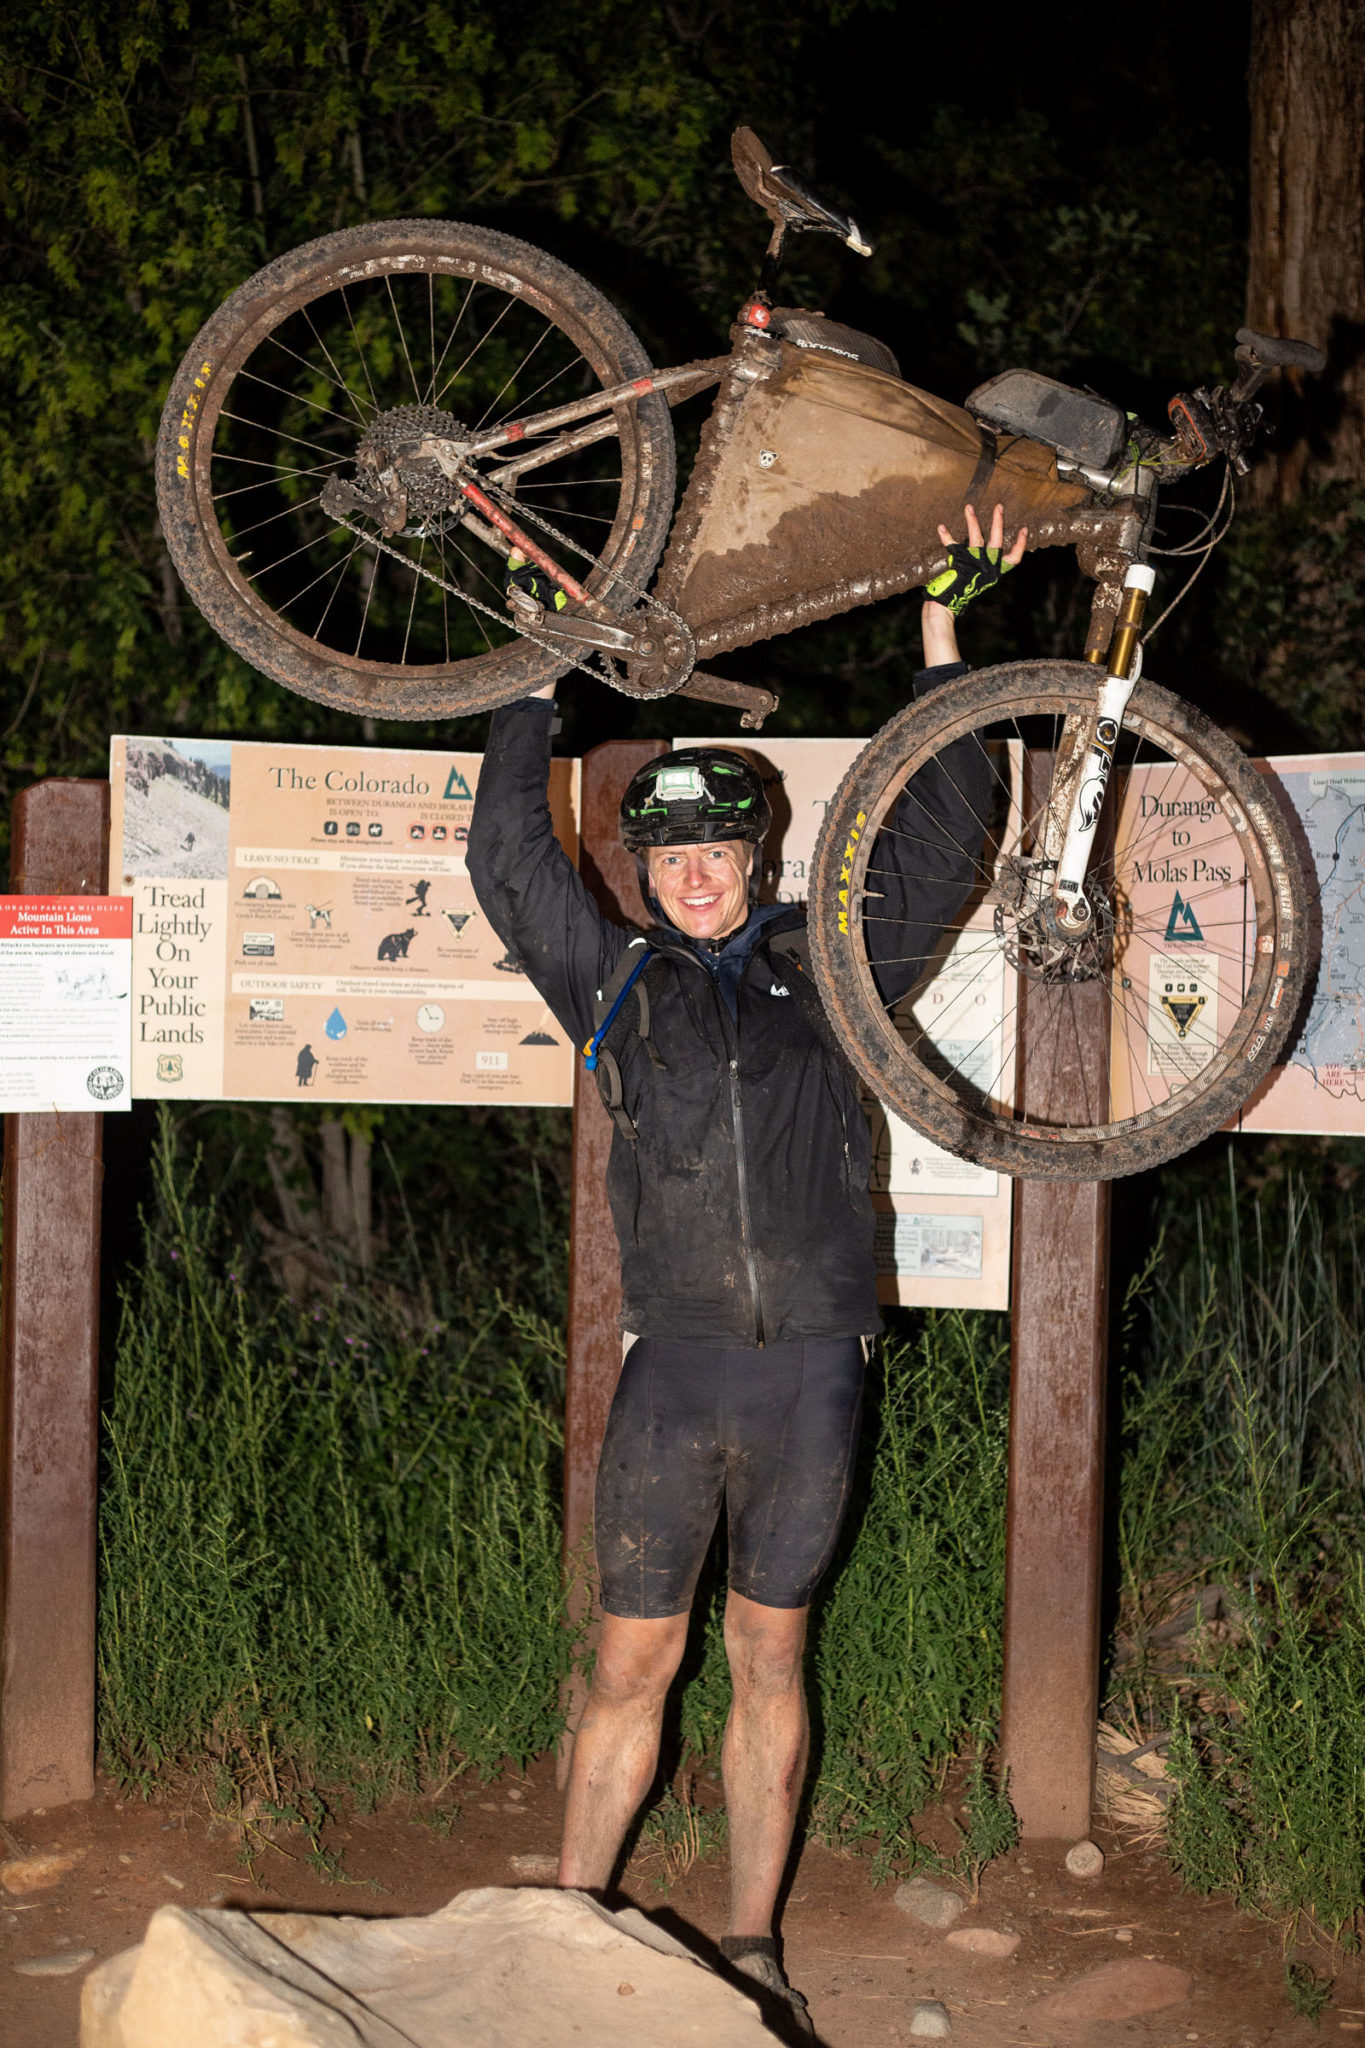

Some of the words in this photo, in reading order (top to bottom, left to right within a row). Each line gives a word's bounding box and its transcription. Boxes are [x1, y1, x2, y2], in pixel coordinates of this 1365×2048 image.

[269, 766, 317, 791] The
[324, 769, 430, 795] Colorado
[330, 808, 338, 816] IS
[338, 808, 363, 817] OPEN
[416, 801, 436, 810] AND
[1141, 795, 1224, 824] Durango
[1172, 829, 1191, 847] to
[244, 855, 272, 865] LEAVE
[273, 856, 289, 865] NO
[291, 856, 320, 866] TRACE
[838, 810, 866, 936] MAXXIS
[1131, 859, 1188, 883] Molas
[1191, 859, 1231, 882] Pass
[144, 886, 205, 909] Tread
[18, 912, 64, 923] Mountain
[66, 912, 92, 923] Lions
[10, 924, 40, 936] Active
[42, 925, 52, 936] In
[54, 924, 75, 936] This
[76, 926, 100, 936] Area
[136, 913, 212, 943] Lightly
[156, 941, 190, 963] On
[149, 967, 199, 990] Your
[240, 980, 288, 989] OUTDOOR
[289, 981, 323, 990] SAFETY
[139, 994, 206, 1017] Public
[139, 1021, 204, 1044] Lands
[480, 1056, 500, 1067] 911
[1324, 1062, 1342, 1070] YOU
[1322, 1078, 1344, 1086] HERE
